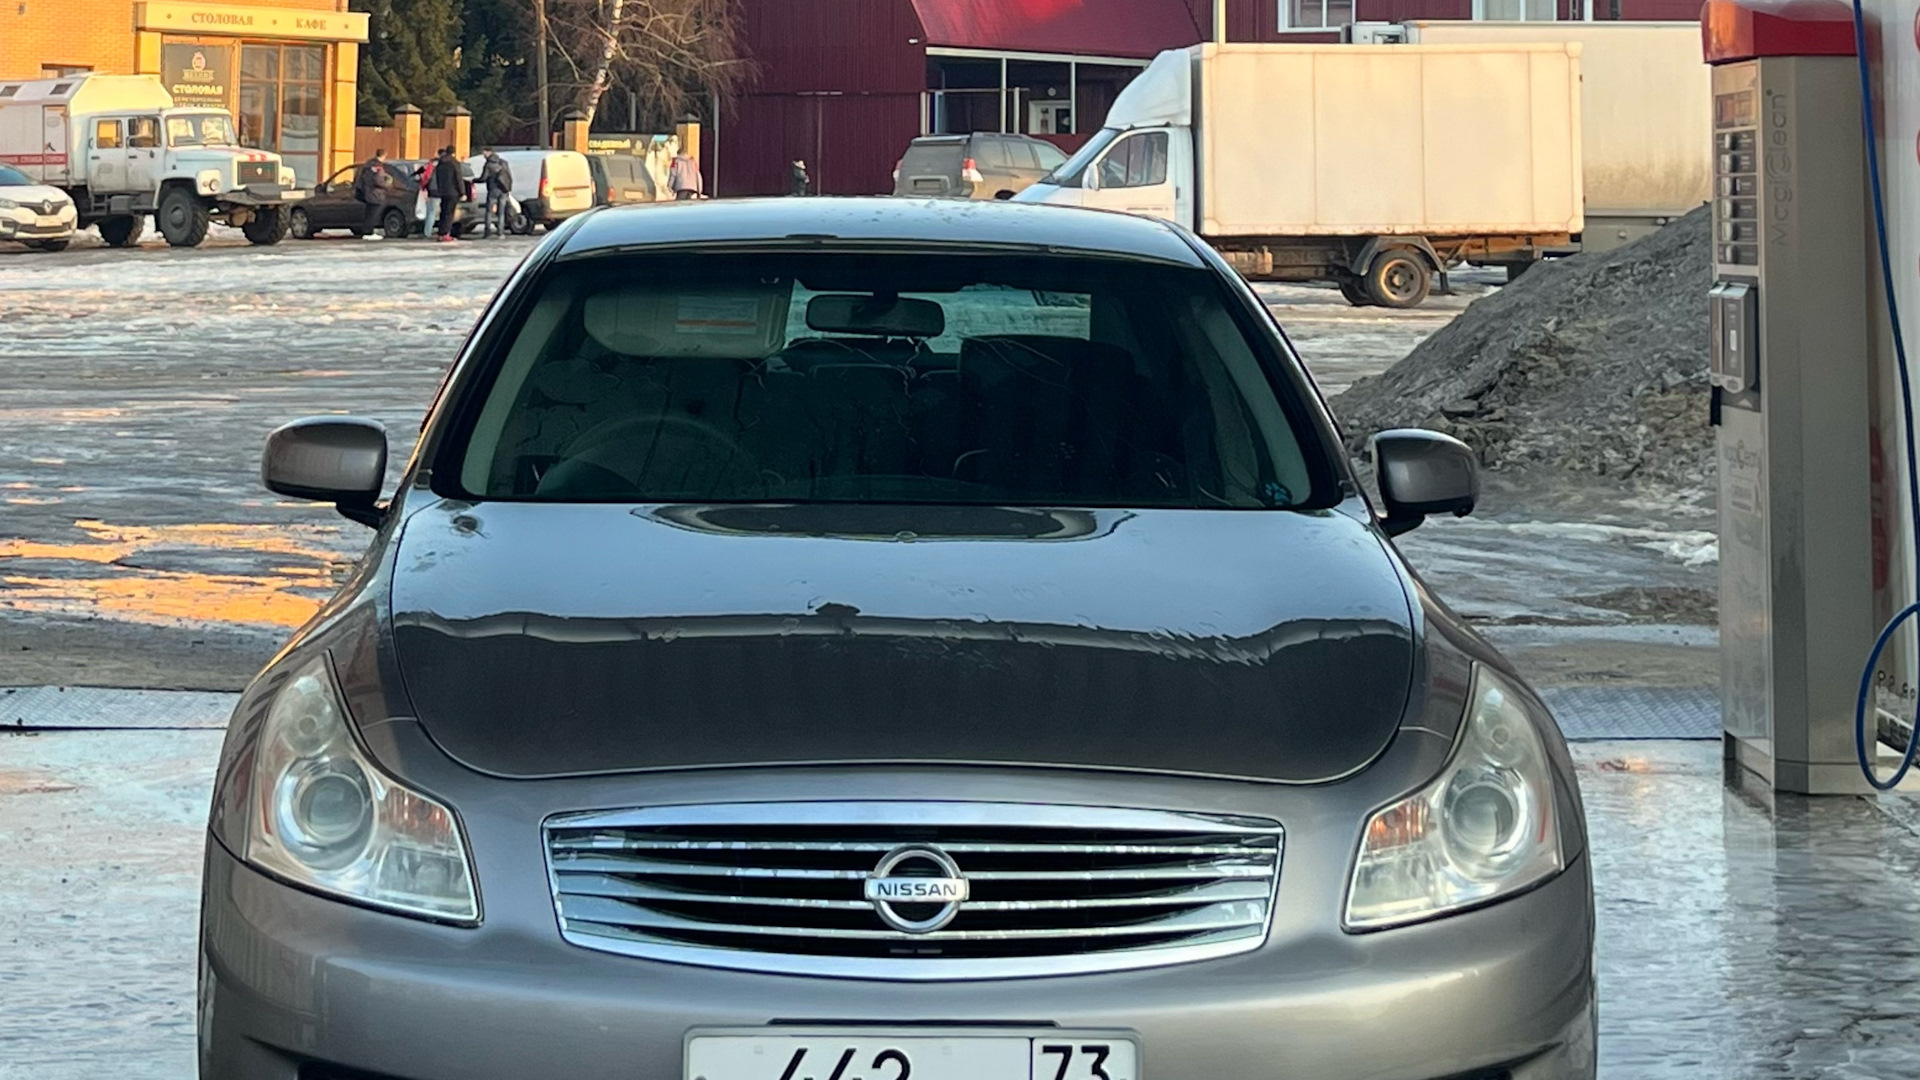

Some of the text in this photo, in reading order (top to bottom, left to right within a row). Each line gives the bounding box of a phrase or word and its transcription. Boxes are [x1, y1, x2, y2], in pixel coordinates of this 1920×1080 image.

[191, 12, 327, 31] СТОЛОВАЯ КАФЕ
[877, 882, 957, 896] NISSAN
[1041, 1045, 1110, 1080] 73
